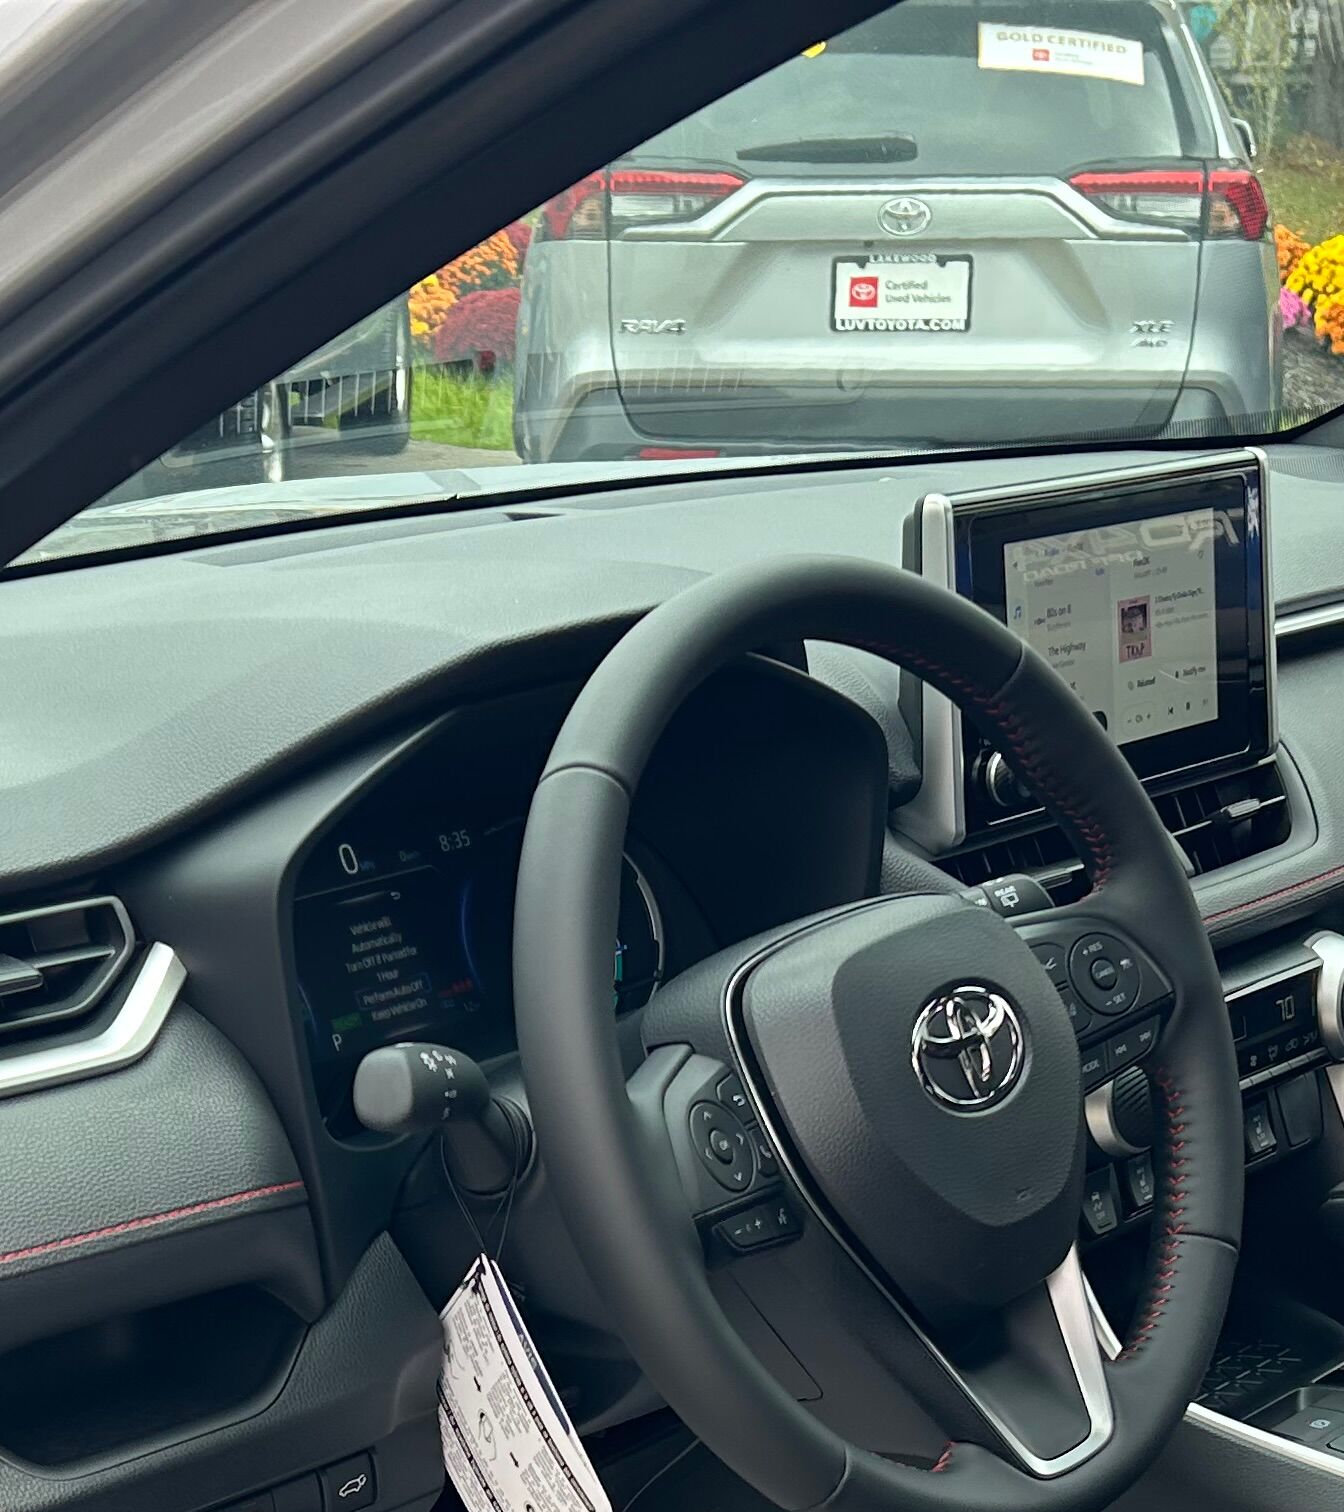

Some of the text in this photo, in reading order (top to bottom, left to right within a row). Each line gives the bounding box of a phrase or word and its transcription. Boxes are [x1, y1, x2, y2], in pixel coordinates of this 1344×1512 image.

[997, 32, 1127, 54] GOLD CERTIFIED
[885, 280, 928, 290] Certified
[885, 293, 951, 303] Used Vehicles
[620, 319, 687, 335] RAV4
[836, 319, 966, 331] LUVTOYOTA.COM
[439, 830, 471, 851] 8:35
[339, 844, 359, 874] 0
[994, 886, 1016, 897] REAR
[1276, 995, 1295, 1021] 70
[332, 1033, 343, 1051] P
